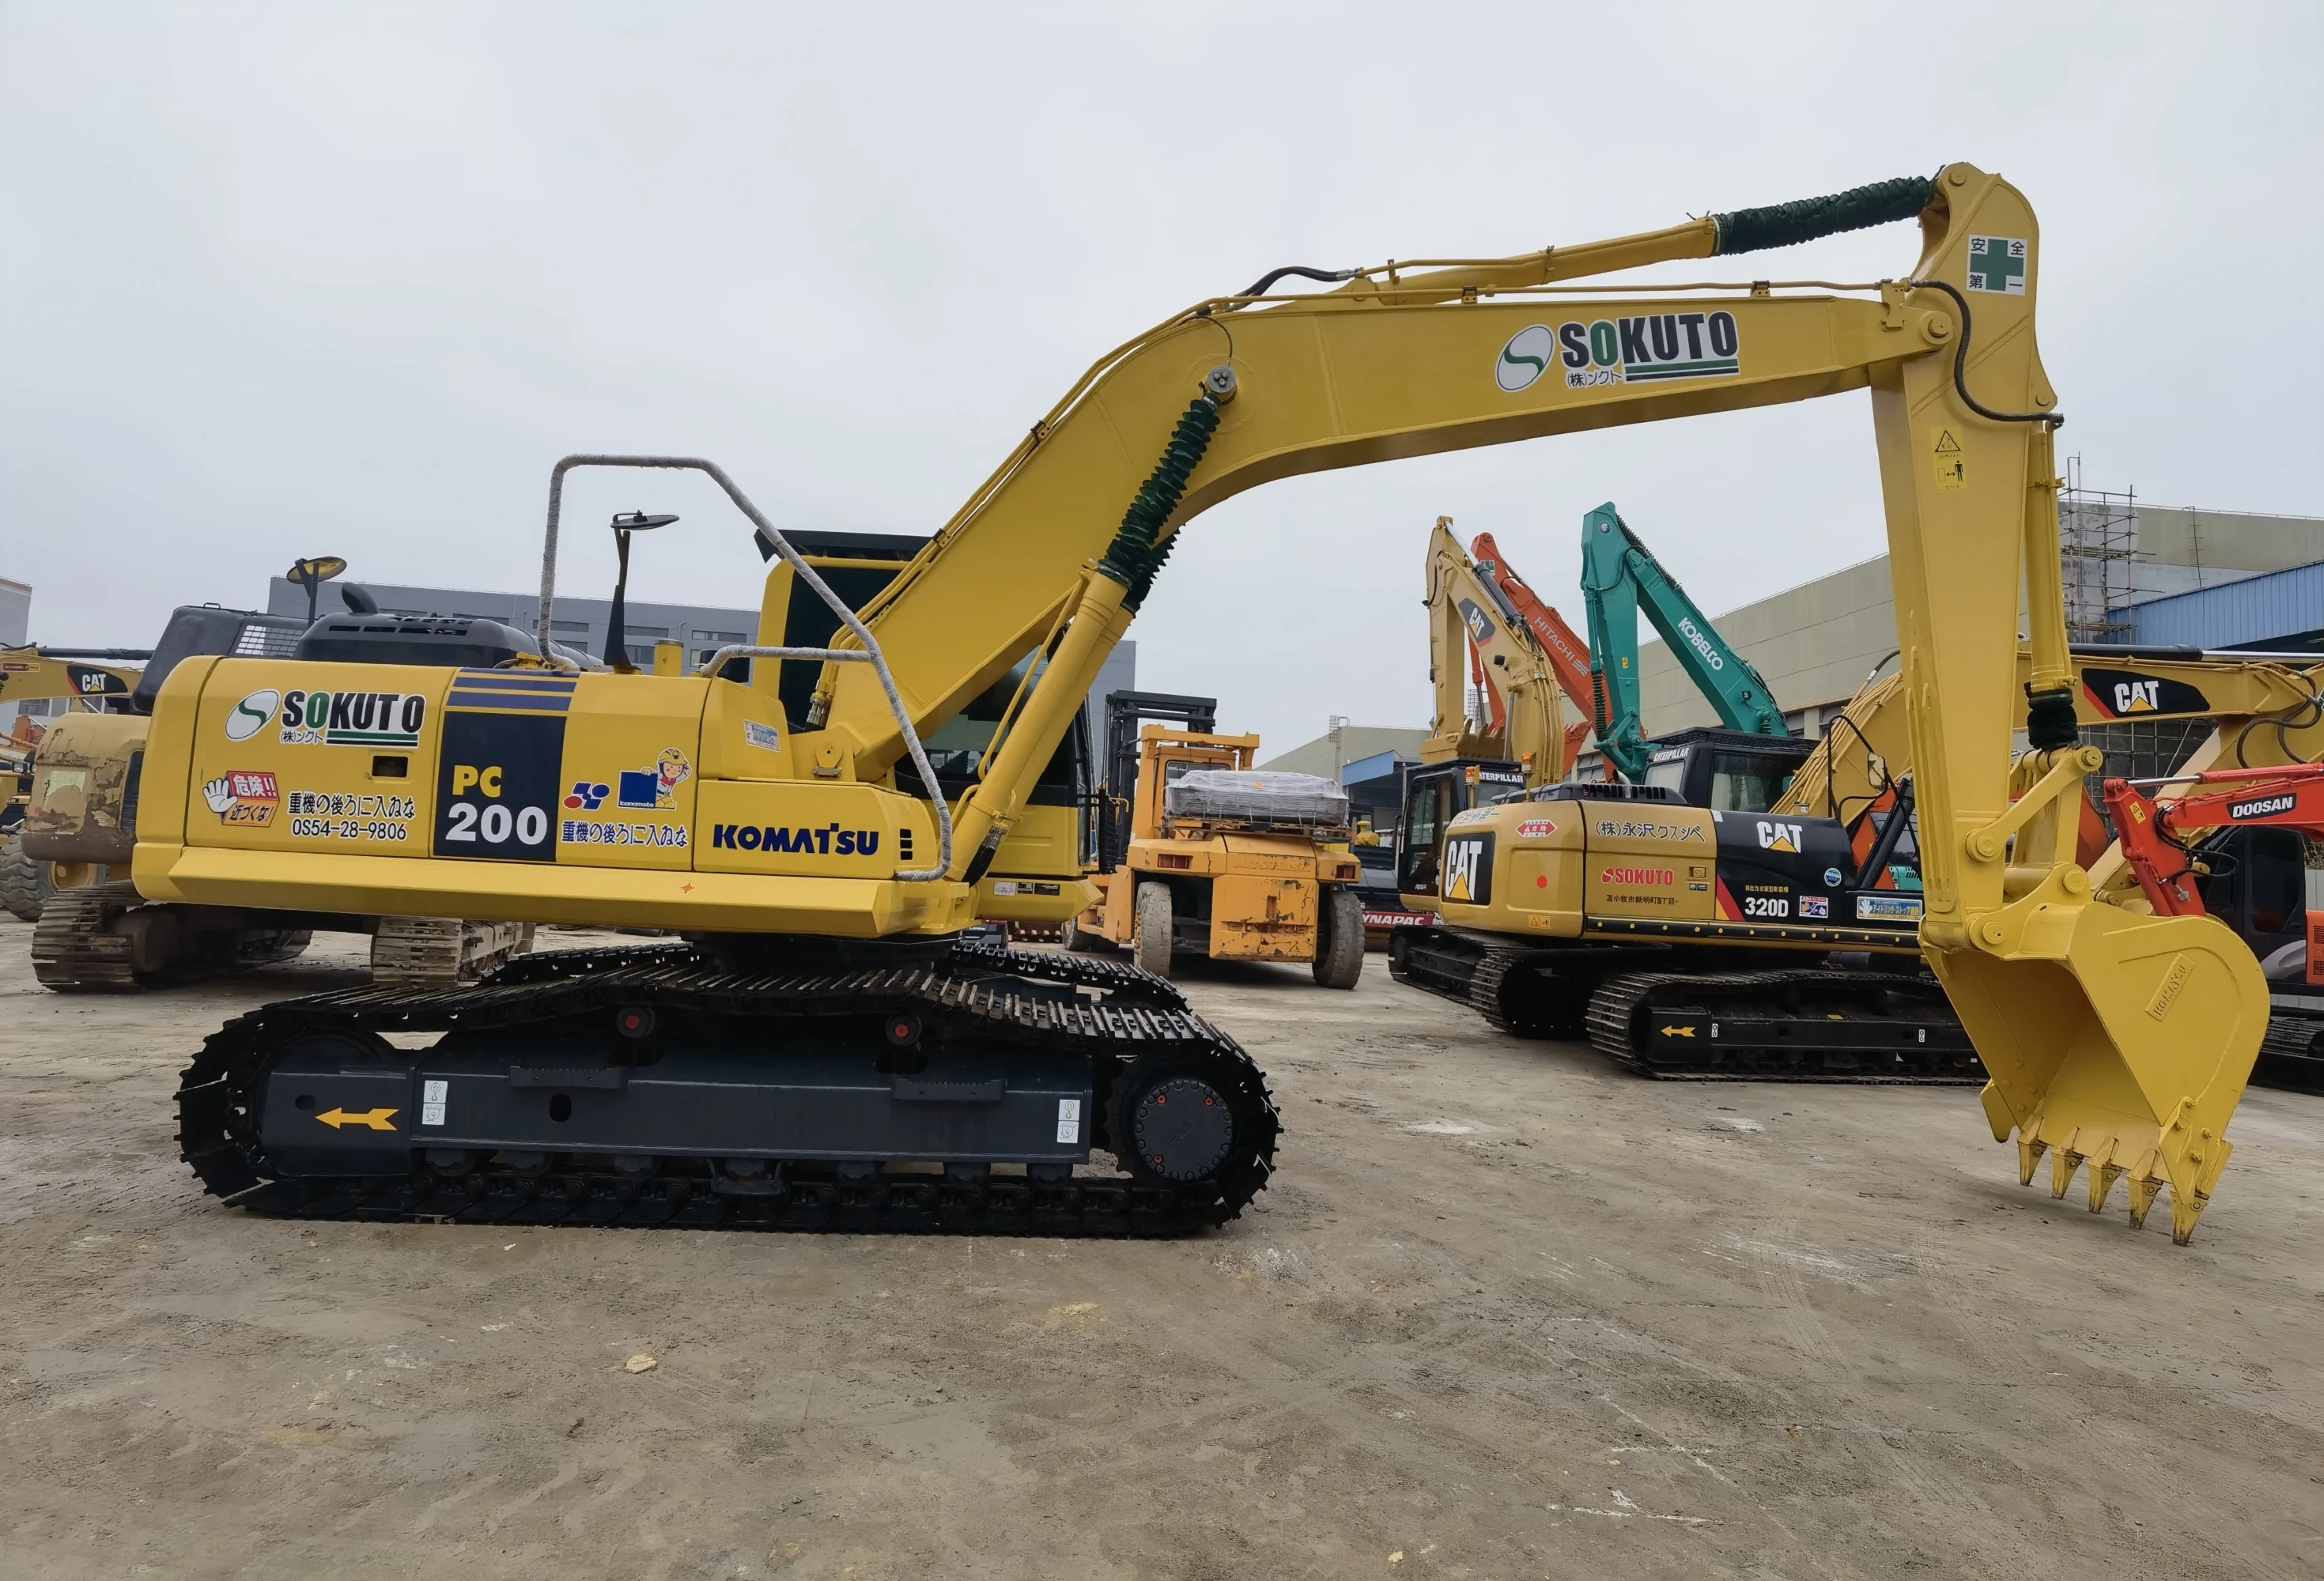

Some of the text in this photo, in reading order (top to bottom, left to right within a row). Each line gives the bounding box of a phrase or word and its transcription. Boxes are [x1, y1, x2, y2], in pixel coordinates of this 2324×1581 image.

[1971, 238, 2024, 255] 安 全
[1969, 274, 1983, 289] 第
[1559, 311, 1738, 368] SOKUTO
[1469, 606, 1485, 638] CAT
[1534, 617, 1574, 661] HITACHI
[1678, 617, 1723, 670] KOBELCO
[81, 674, 106, 692] CAT
[2114, 681, 2160, 712] CAT
[282, 690, 425, 733] SOKUTO
[1653, 747, 1690, 762] CATERPILLAR
[452, 764, 502, 798] PC
[1479, 772, 1523, 783] TERPILLAR
[2232, 796, 2293, 818] DOOSAN
[445, 802, 547, 845] 200
[712, 822, 879, 855] KOMATSU
[1756, 821, 1803, 853] CAT
[1445, 840, 1483, 901] CAT
[1614, 867, 1674, 885] SOKUTO
[1362, 914, 1424, 926] YNAPAC
[1744, 896, 1789, 917] 320D
